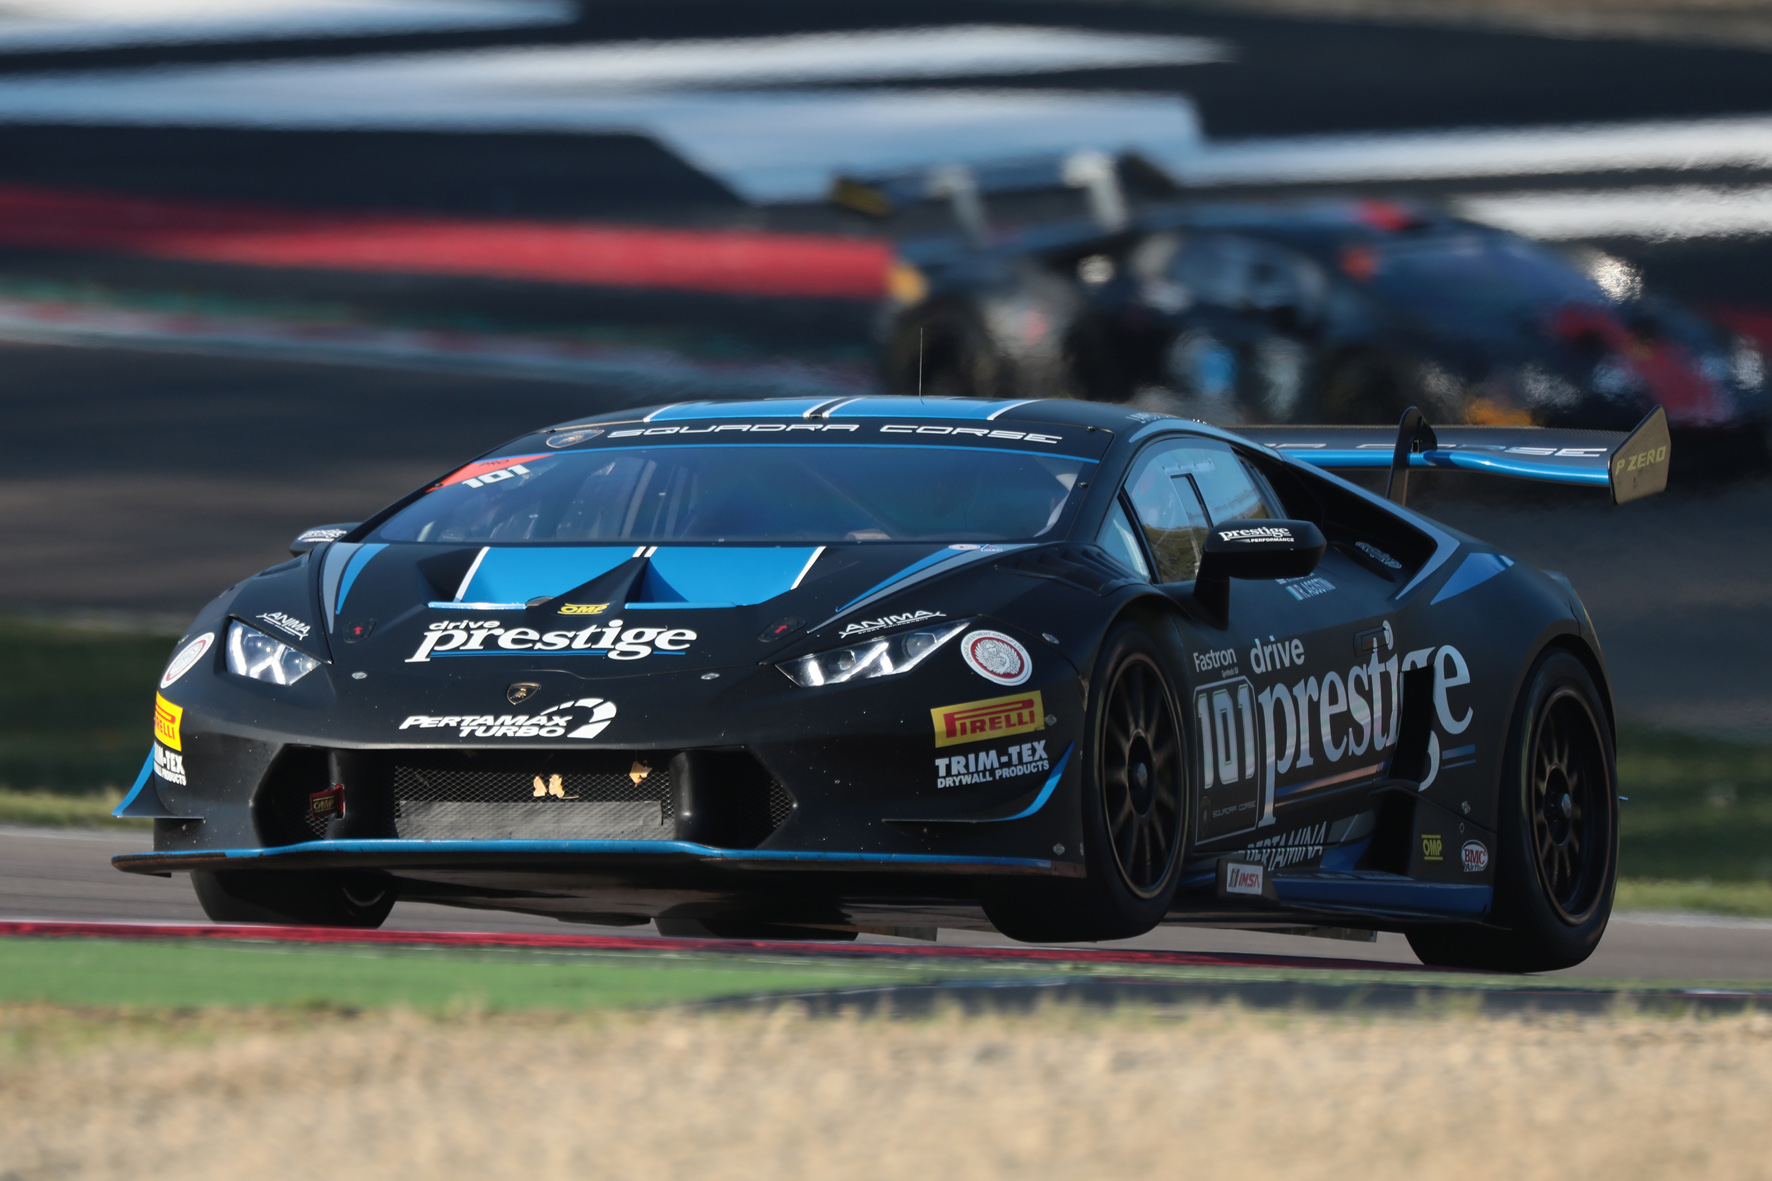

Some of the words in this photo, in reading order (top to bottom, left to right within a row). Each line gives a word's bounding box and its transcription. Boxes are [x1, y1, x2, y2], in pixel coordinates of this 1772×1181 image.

[606, 423, 860, 438] SQUADRA
[879, 424, 1063, 444] CORSE
[1615, 460, 1626, 476] P
[1627, 446, 1667, 471] ZERO
[461, 464, 531, 489] 101
[1218, 526, 1292, 542] prestige
[560, 604, 609, 614] OMP
[267, 612, 311, 635] ANIMA
[429, 620, 501, 631] drive
[845, 610, 936, 633] ANIMA
[404, 619, 698, 662] prestige
[1193, 648, 1238, 673] Fastron
[1250, 635, 1305, 675] drive
[155, 702, 176, 741] RELLI
[399, 715, 573, 730] PERTAMAX
[943, 698, 1036, 739] PIRELLI
[459, 725, 567, 738] TURBO
[1198, 683, 1256, 790] 101
[935, 740, 1049, 778] TRIM-TEX
[937, 773, 993, 789] DRYWALL
[995, 760, 1050, 781] PRODUCTS
[1422, 839, 1443, 856] OMP
[1464, 848, 1486, 865] BMC
[1237, 872, 1261, 889] IMSA
